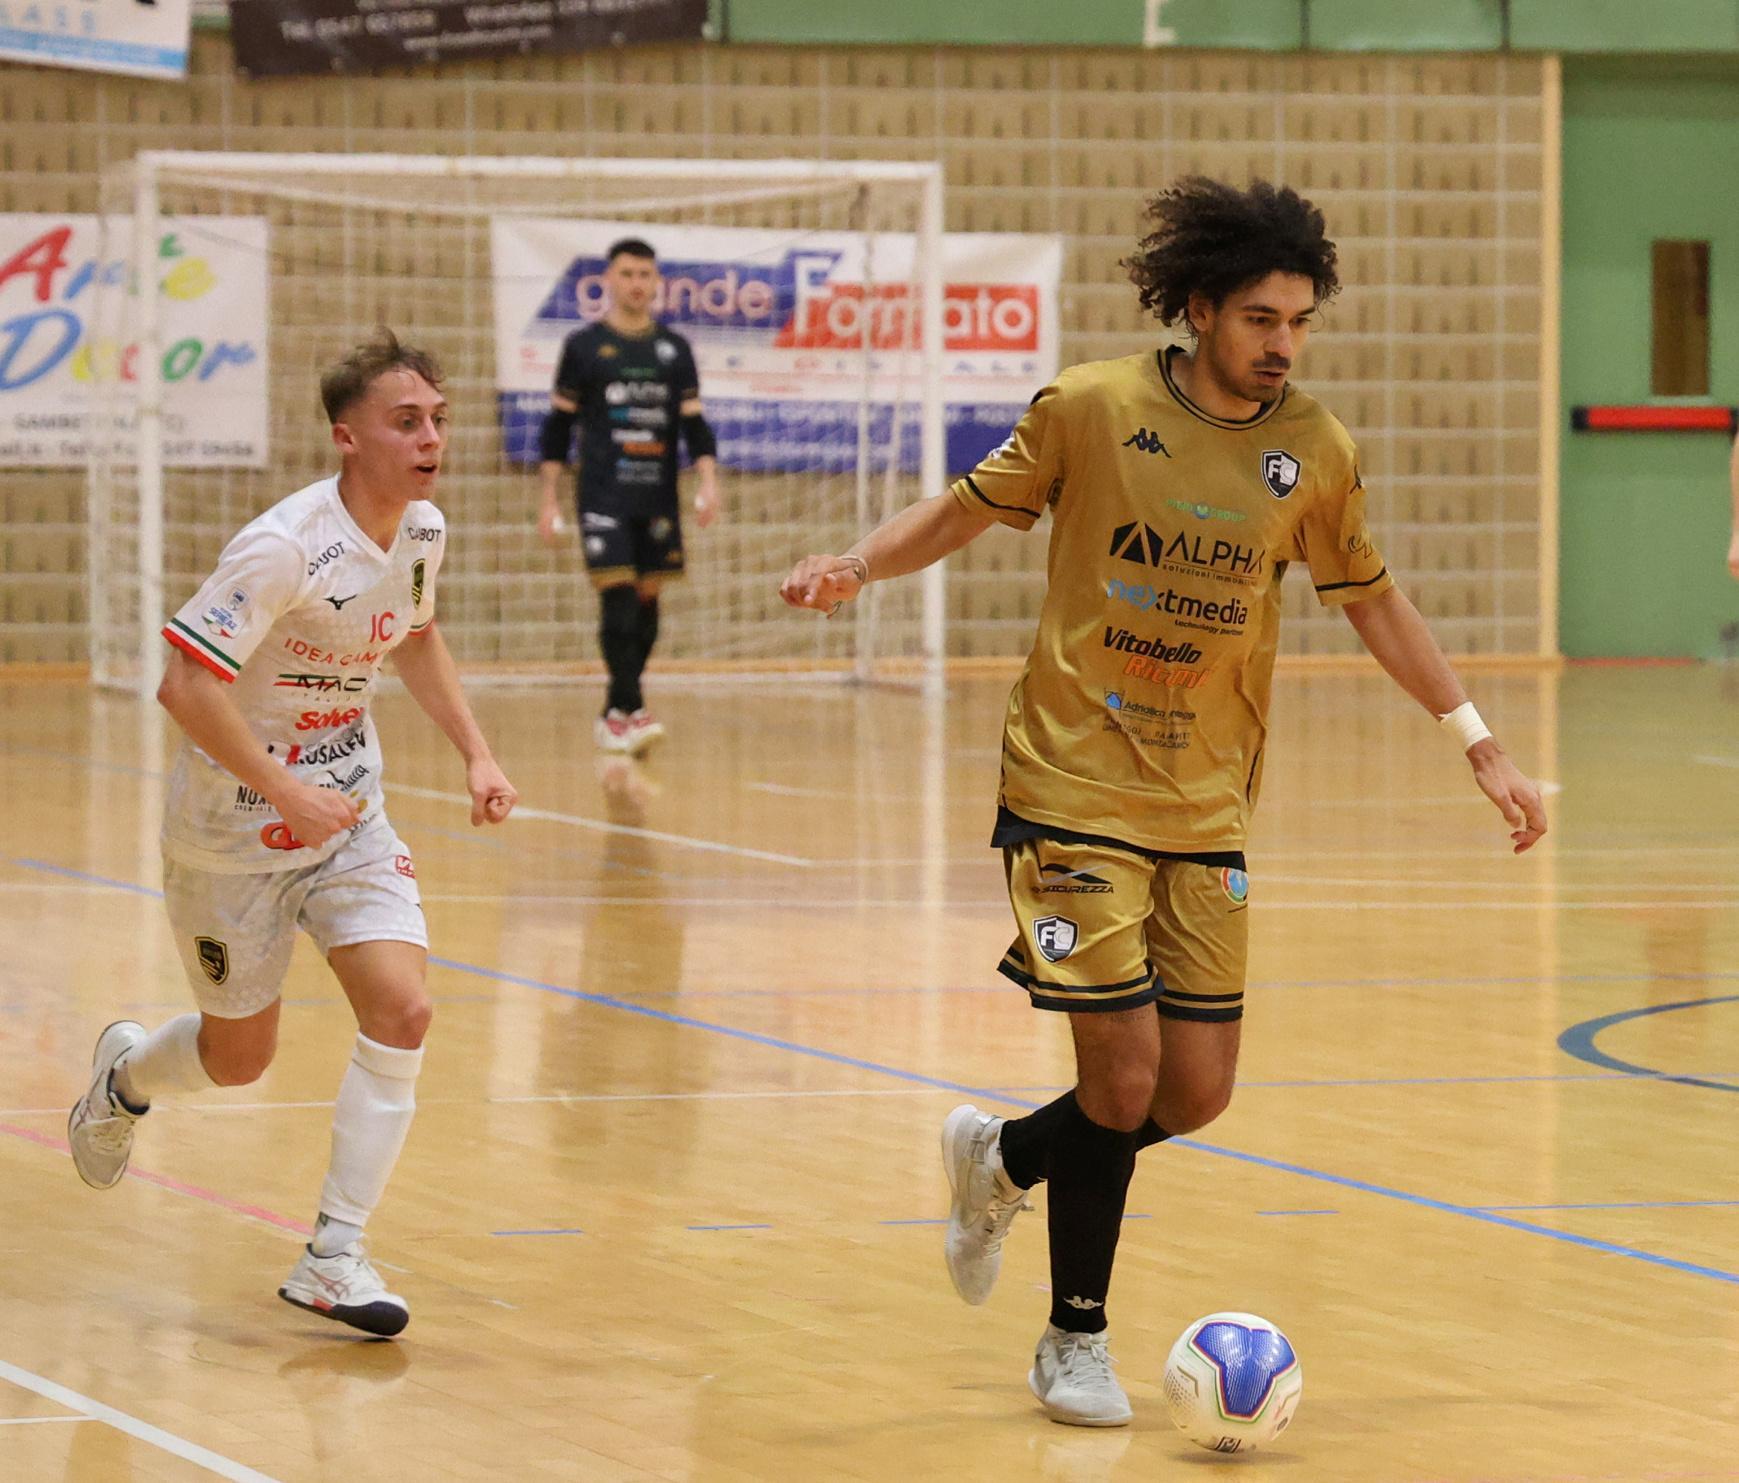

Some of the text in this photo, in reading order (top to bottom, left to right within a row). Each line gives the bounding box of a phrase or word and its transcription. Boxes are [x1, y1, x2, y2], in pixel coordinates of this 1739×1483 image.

[575, 267, 773, 322] gnde
[407, 527, 441, 542] CBOT
[1105, 577, 1248, 625] nextmedia
[283, 638, 333, 665] IDEA
[1103, 626, 1202, 664] Vitobello
